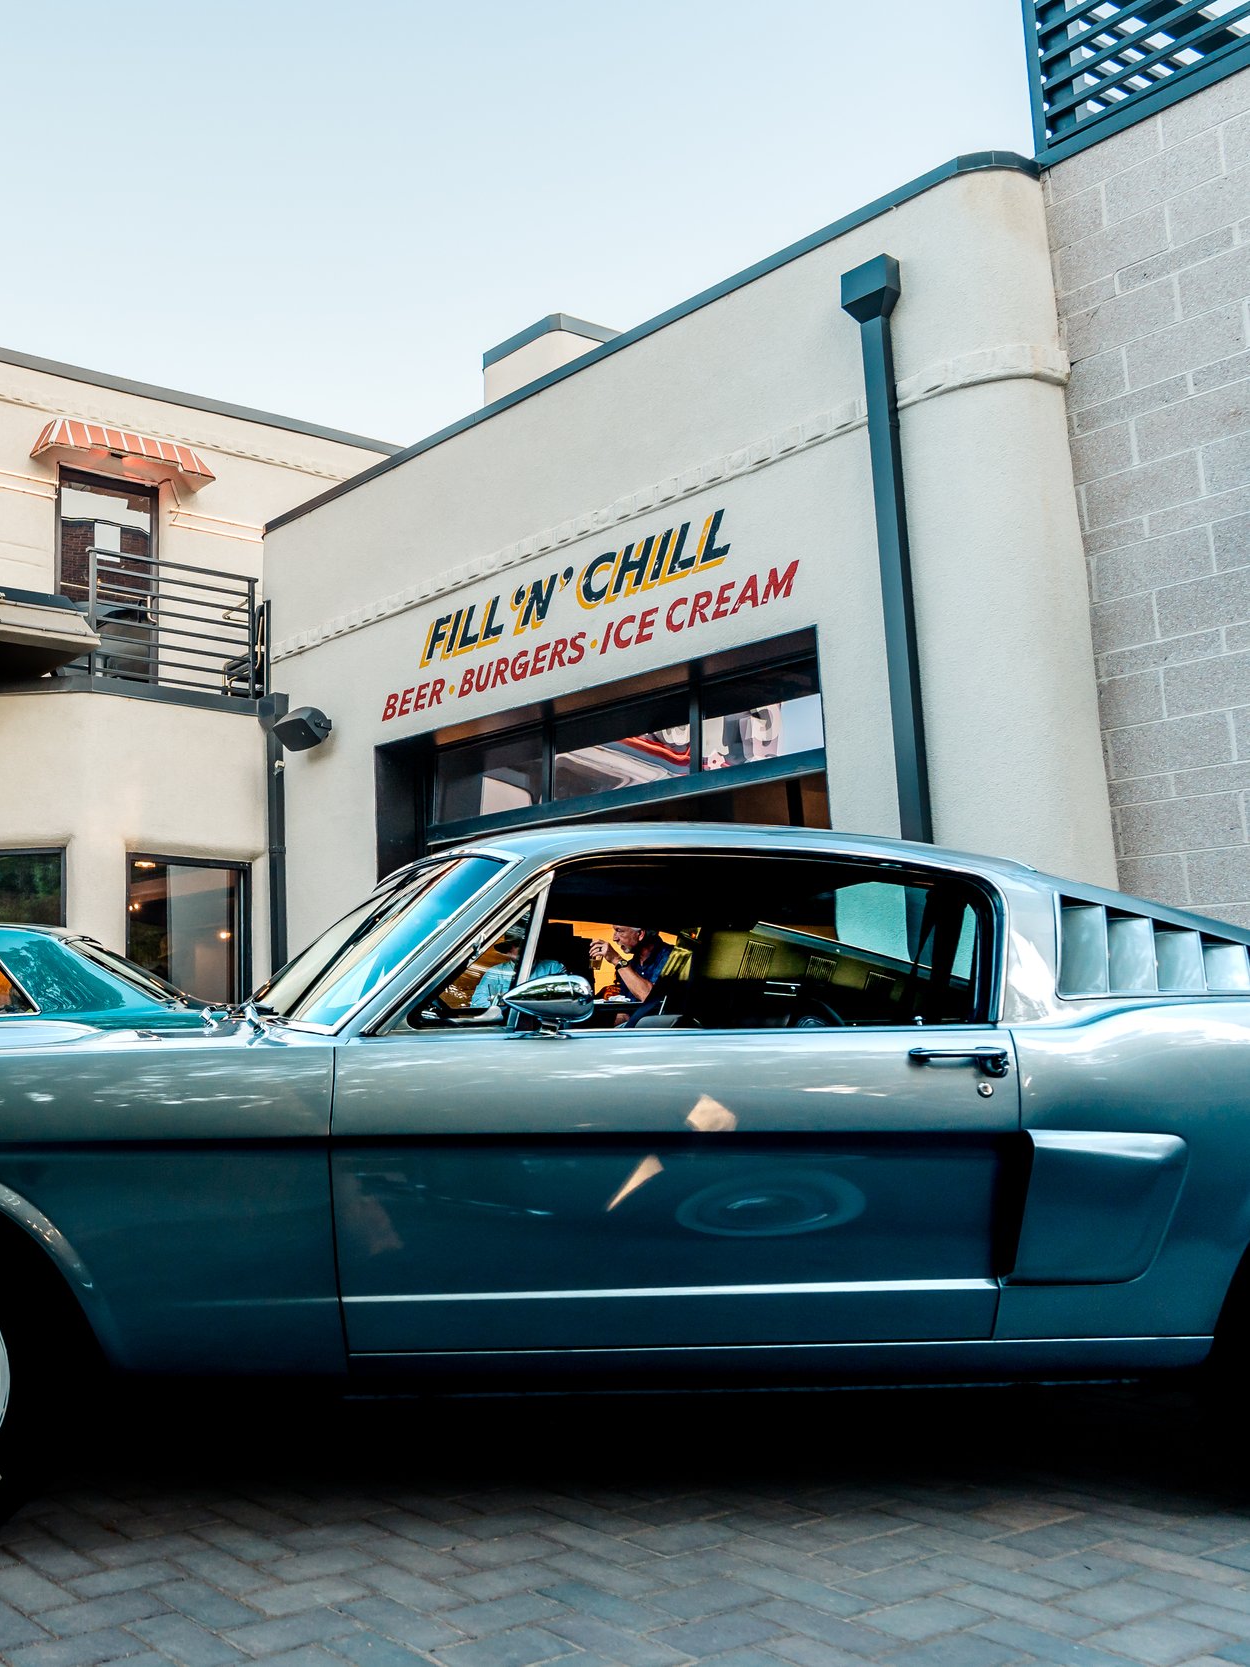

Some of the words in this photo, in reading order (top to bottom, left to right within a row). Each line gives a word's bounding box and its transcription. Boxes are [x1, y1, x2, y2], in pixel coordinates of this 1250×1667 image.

[382, 678, 446, 721] BEER
[457, 631, 587, 698] BURGERS
[599, 608, 659, 655] ICE
[665, 559, 800, 633] CREAM
[419, 594, 504, 668] FILL
[576, 508, 731, 610] CHILL
